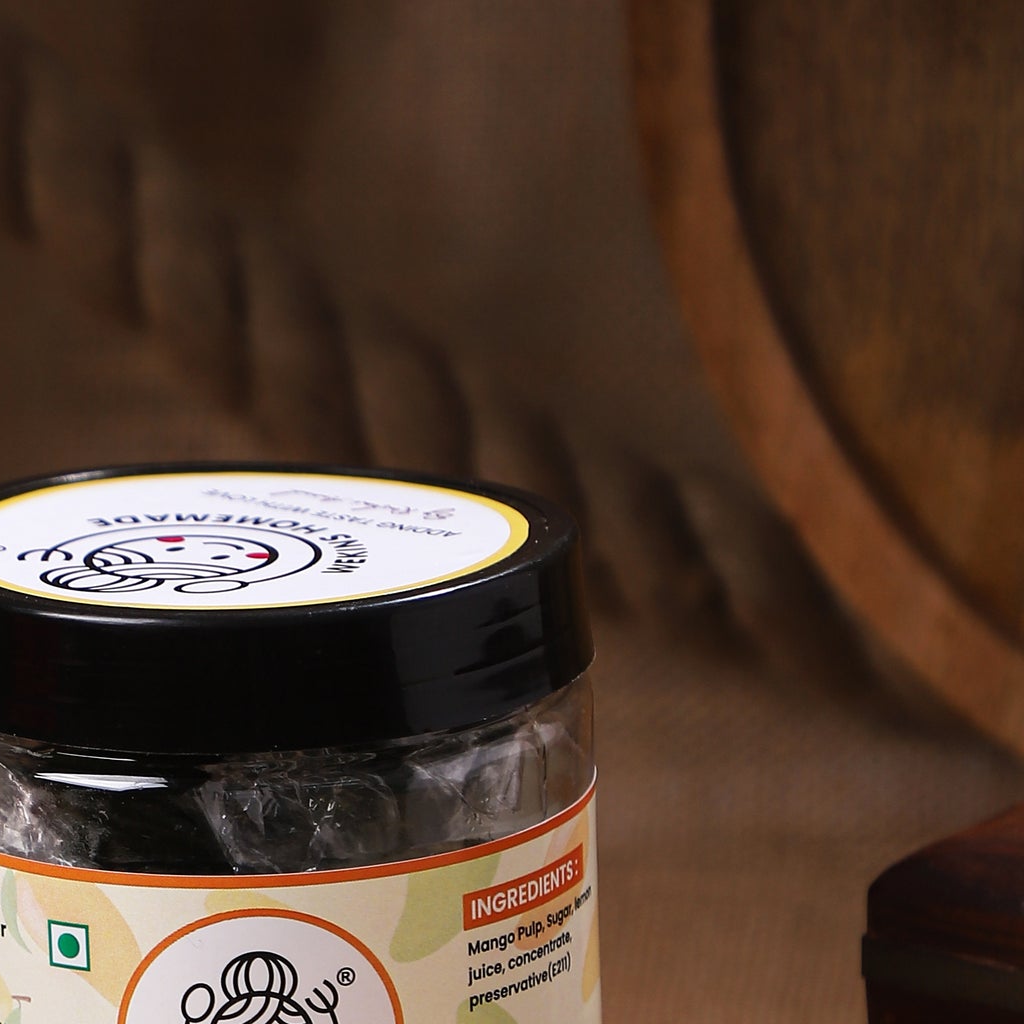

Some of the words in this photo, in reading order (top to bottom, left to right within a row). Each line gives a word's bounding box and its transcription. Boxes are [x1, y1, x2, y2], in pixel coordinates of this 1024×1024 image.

[88, 513, 328, 534] HOMEMADE
[376, 521, 463, 538] ADDING
[319, 533, 369, 574] WEKINS
[468, 931, 515, 956] Mango
[518, 920, 546, 942] Pulp,
[546, 903, 574, 928] Sugar,
[468, 962, 506, 987] juice,
[508, 931, 572, 970] concentrate,
